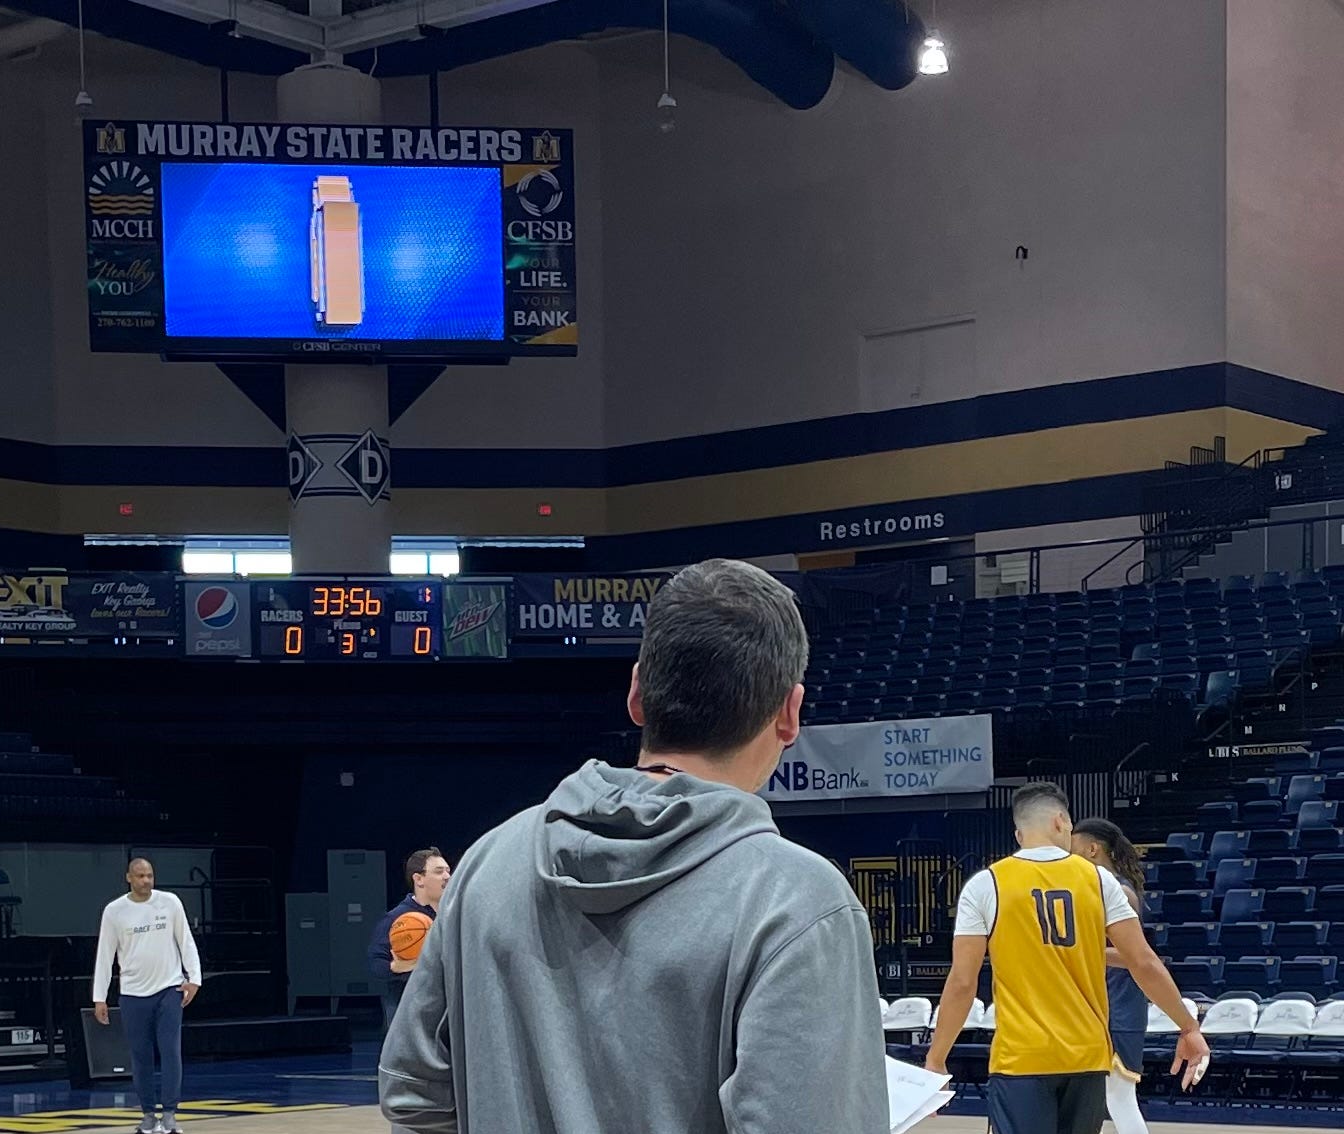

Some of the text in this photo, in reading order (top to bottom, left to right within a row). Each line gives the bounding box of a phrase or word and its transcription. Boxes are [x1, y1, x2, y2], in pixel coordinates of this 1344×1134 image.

[137, 123, 522, 162] MURRAY STATE RACERS
[92, 220, 154, 238] MCCH
[508, 220, 573, 241] CFSB
[96, 281, 134, 295] YOU
[520, 271, 568, 287] LIFE.
[362, 450, 383, 484] D
[820, 511, 945, 541] Restrooms
[555, 577, 661, 603] MURRAY
[313, 587, 381, 616] 33:56
[25, 622, 43, 631] KEY
[45, 622, 77, 631] GROUP
[261, 610, 303, 622] RACERS
[395, 611, 428, 622] GUEST
[518, 604, 594, 630] HOME
[601, 604, 621, 628] &
[342, 633, 354, 655] 3
[884, 728, 931, 745] START
[884, 746, 982, 767] SOMETHING
[812, 767, 860, 791] Bank
[885, 772, 939, 789] TODAY
[1171, 773, 1179, 782] K
[1032, 887, 1077, 948] 10
[926, 934, 933, 944] D
